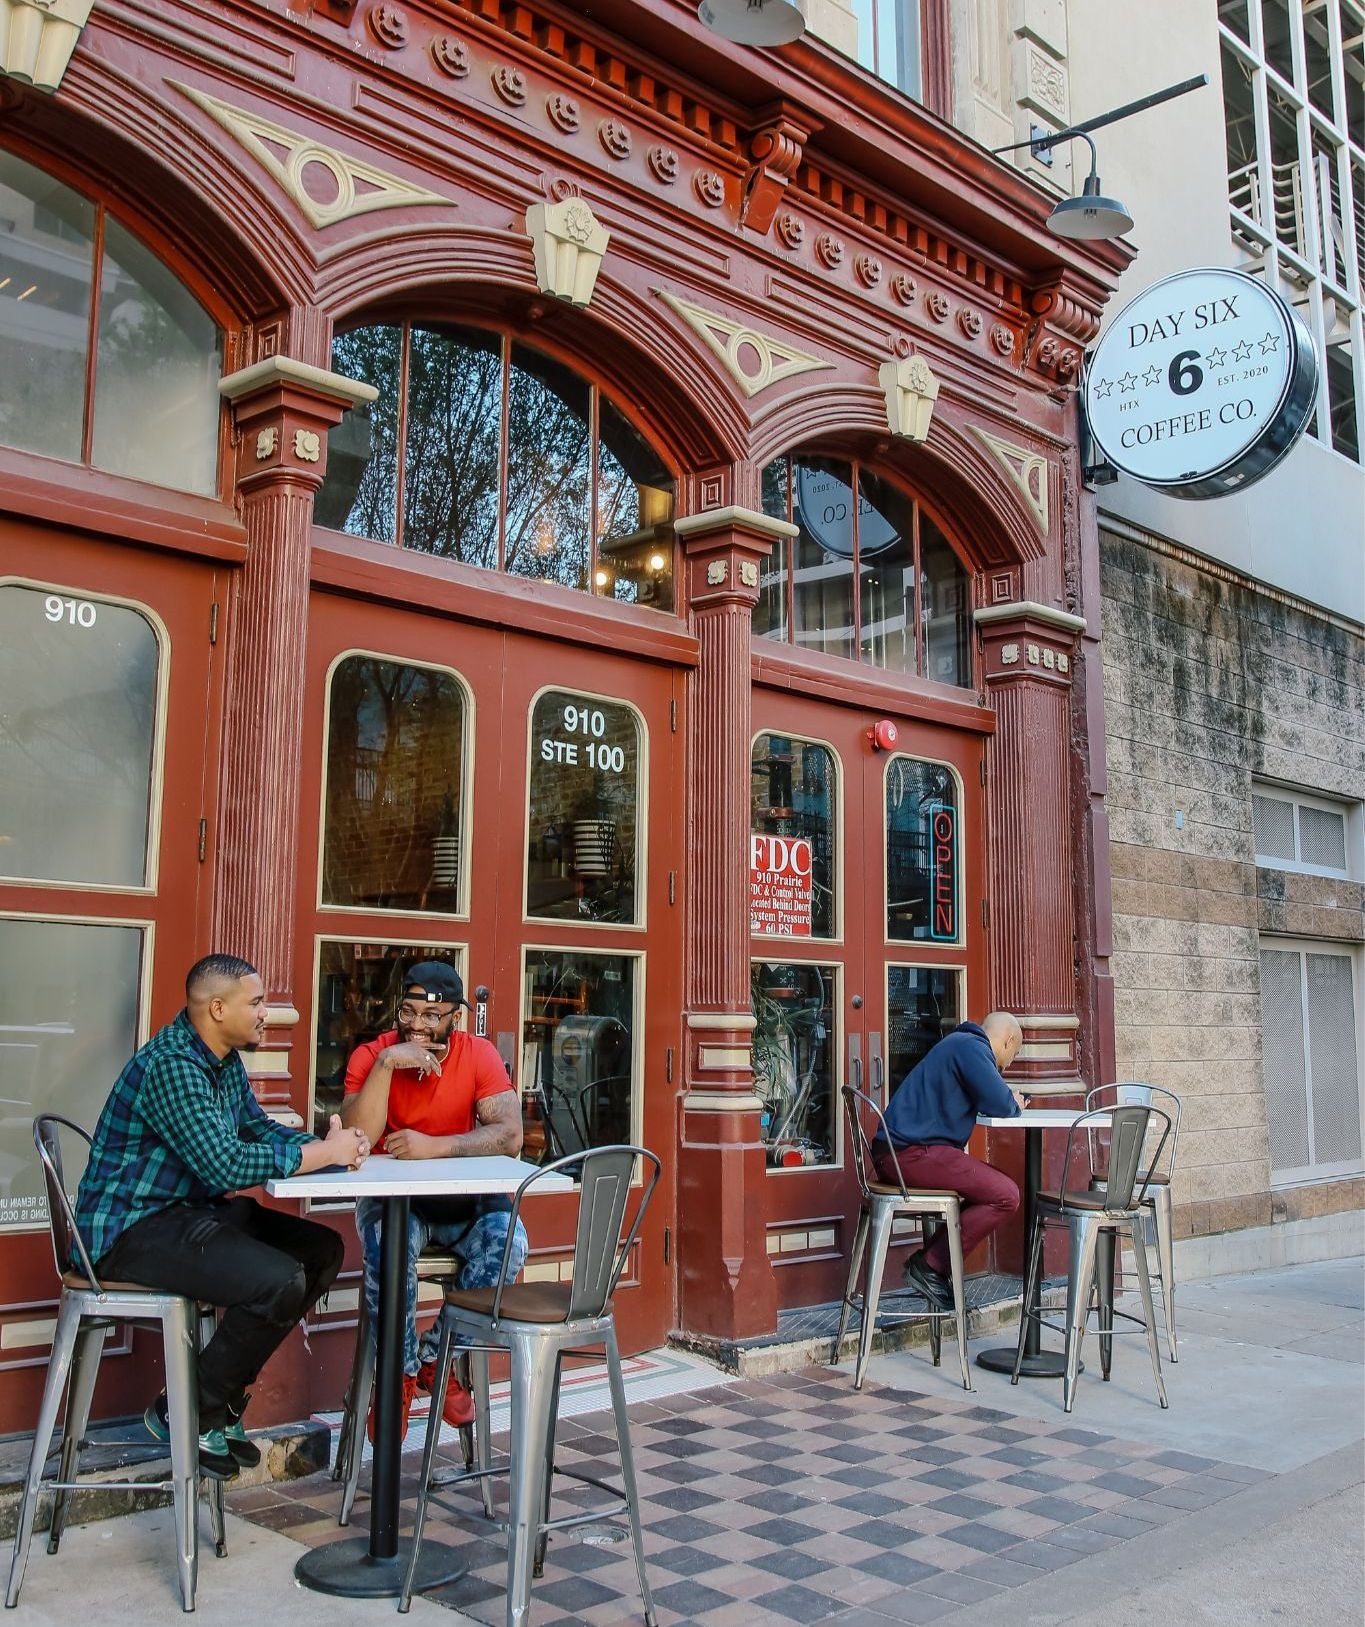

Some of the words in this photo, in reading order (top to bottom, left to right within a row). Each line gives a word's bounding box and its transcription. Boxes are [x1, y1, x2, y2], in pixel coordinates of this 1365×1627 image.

[1128, 311, 1186, 349] DAY
[1194, 295, 1240, 330] SIX
[1168, 350, 1204, 396] 6
[1217, 374, 1240, 386] EST.
[1243, 365, 1269, 380] 2020
[1119, 400, 1140, 412] HTX
[1121, 408, 1211, 449] COFFEE
[1219, 398, 1257, 425] CO.
[45, 595, 97, 628] 910
[564, 705, 605, 737] 910
[541, 739, 578, 765] STE
[585, 742, 625, 773] 100
[750, 835, 811, 875] FDC
[756, 871, 772, 884] 910
[773, 873, 803, 887] Prairie
[934, 812, 953, 933] OPEN
[771, 885, 794, 899] Control
[772, 898, 793, 911] Behind
[765, 922, 776, 934] 60
[778, 923, 793, 935] PSI
[778, 911, 810, 925] Pressure
